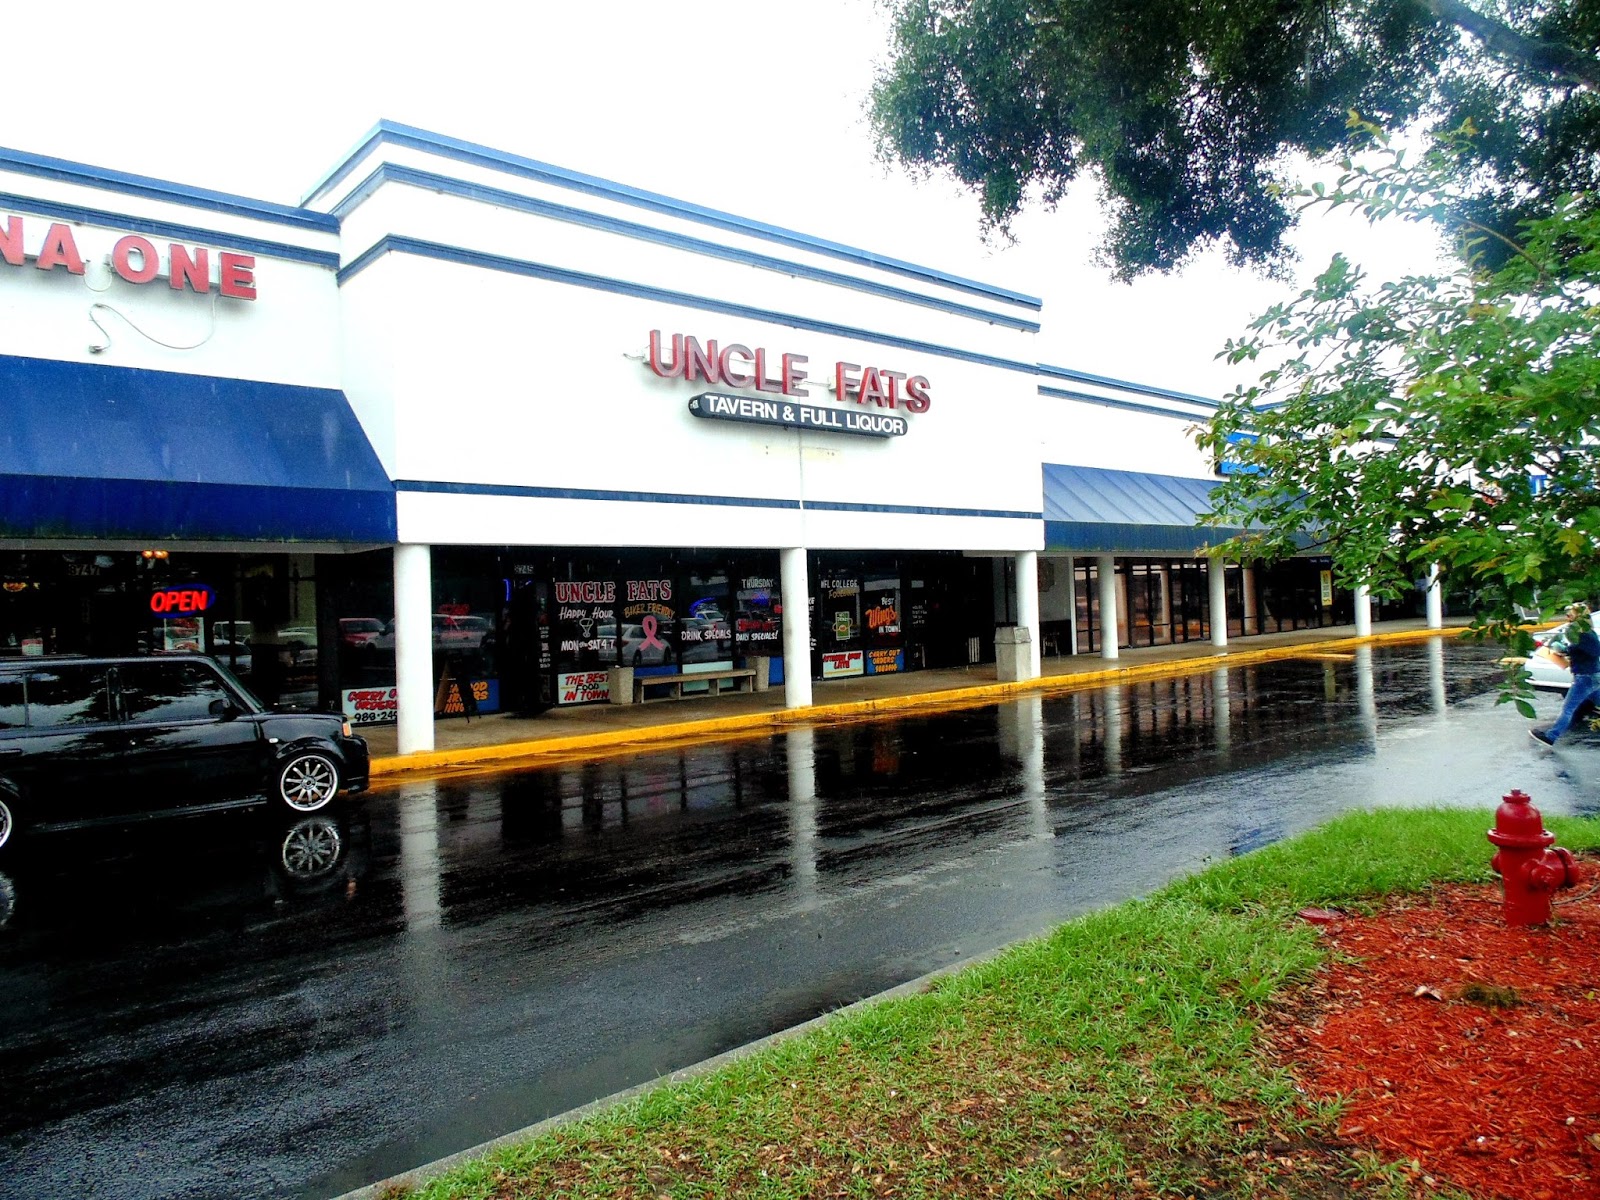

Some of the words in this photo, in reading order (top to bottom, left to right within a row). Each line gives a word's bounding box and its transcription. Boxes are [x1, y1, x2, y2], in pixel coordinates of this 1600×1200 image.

[112, 235, 257, 300] ONE
[649, 329, 809, 397] UNCLE
[835, 361, 931, 413] FATS
[705, 395, 778, 420] TAVERN
[782, 405, 795, 422] &
[800, 407, 842, 428] FULL
[846, 413, 904, 435] LIQUOR
[741, 578, 774, 589] THURSDAY
[831, 579, 859, 589] COLLEGE
[555, 581, 616, 603] UNCLE
[626, 580, 672, 601] FATS
[150, 590, 209, 613] OPEN
[881, 597, 894, 606] BEST
[558, 606, 587, 620] HAPPY
[591, 606, 614, 619] HOUR
[623, 603, 646, 619] BIKER
[646, 602, 676, 619] FRIENDLY
[681, 630, 703, 642] DRINK
[704, 629, 732, 640] SPECIALS
[735, 633, 750, 641] DAILY
[751, 630, 779, 641] SPECIALS!
[560, 640, 579, 652] MON
[588, 639, 601, 650] SAT
[868, 650, 888, 658] CARRY
[888, 649, 901, 657] OUT
[872, 656, 895, 664] ORDERS
[565, 675, 584, 686] THE
[586, 672, 609, 683] BEST
[575, 683, 599, 692] FOOD
[348, 690, 386, 702] CARRY
[564, 690, 578, 701] IN
[580, 689, 609, 701] TOWN
